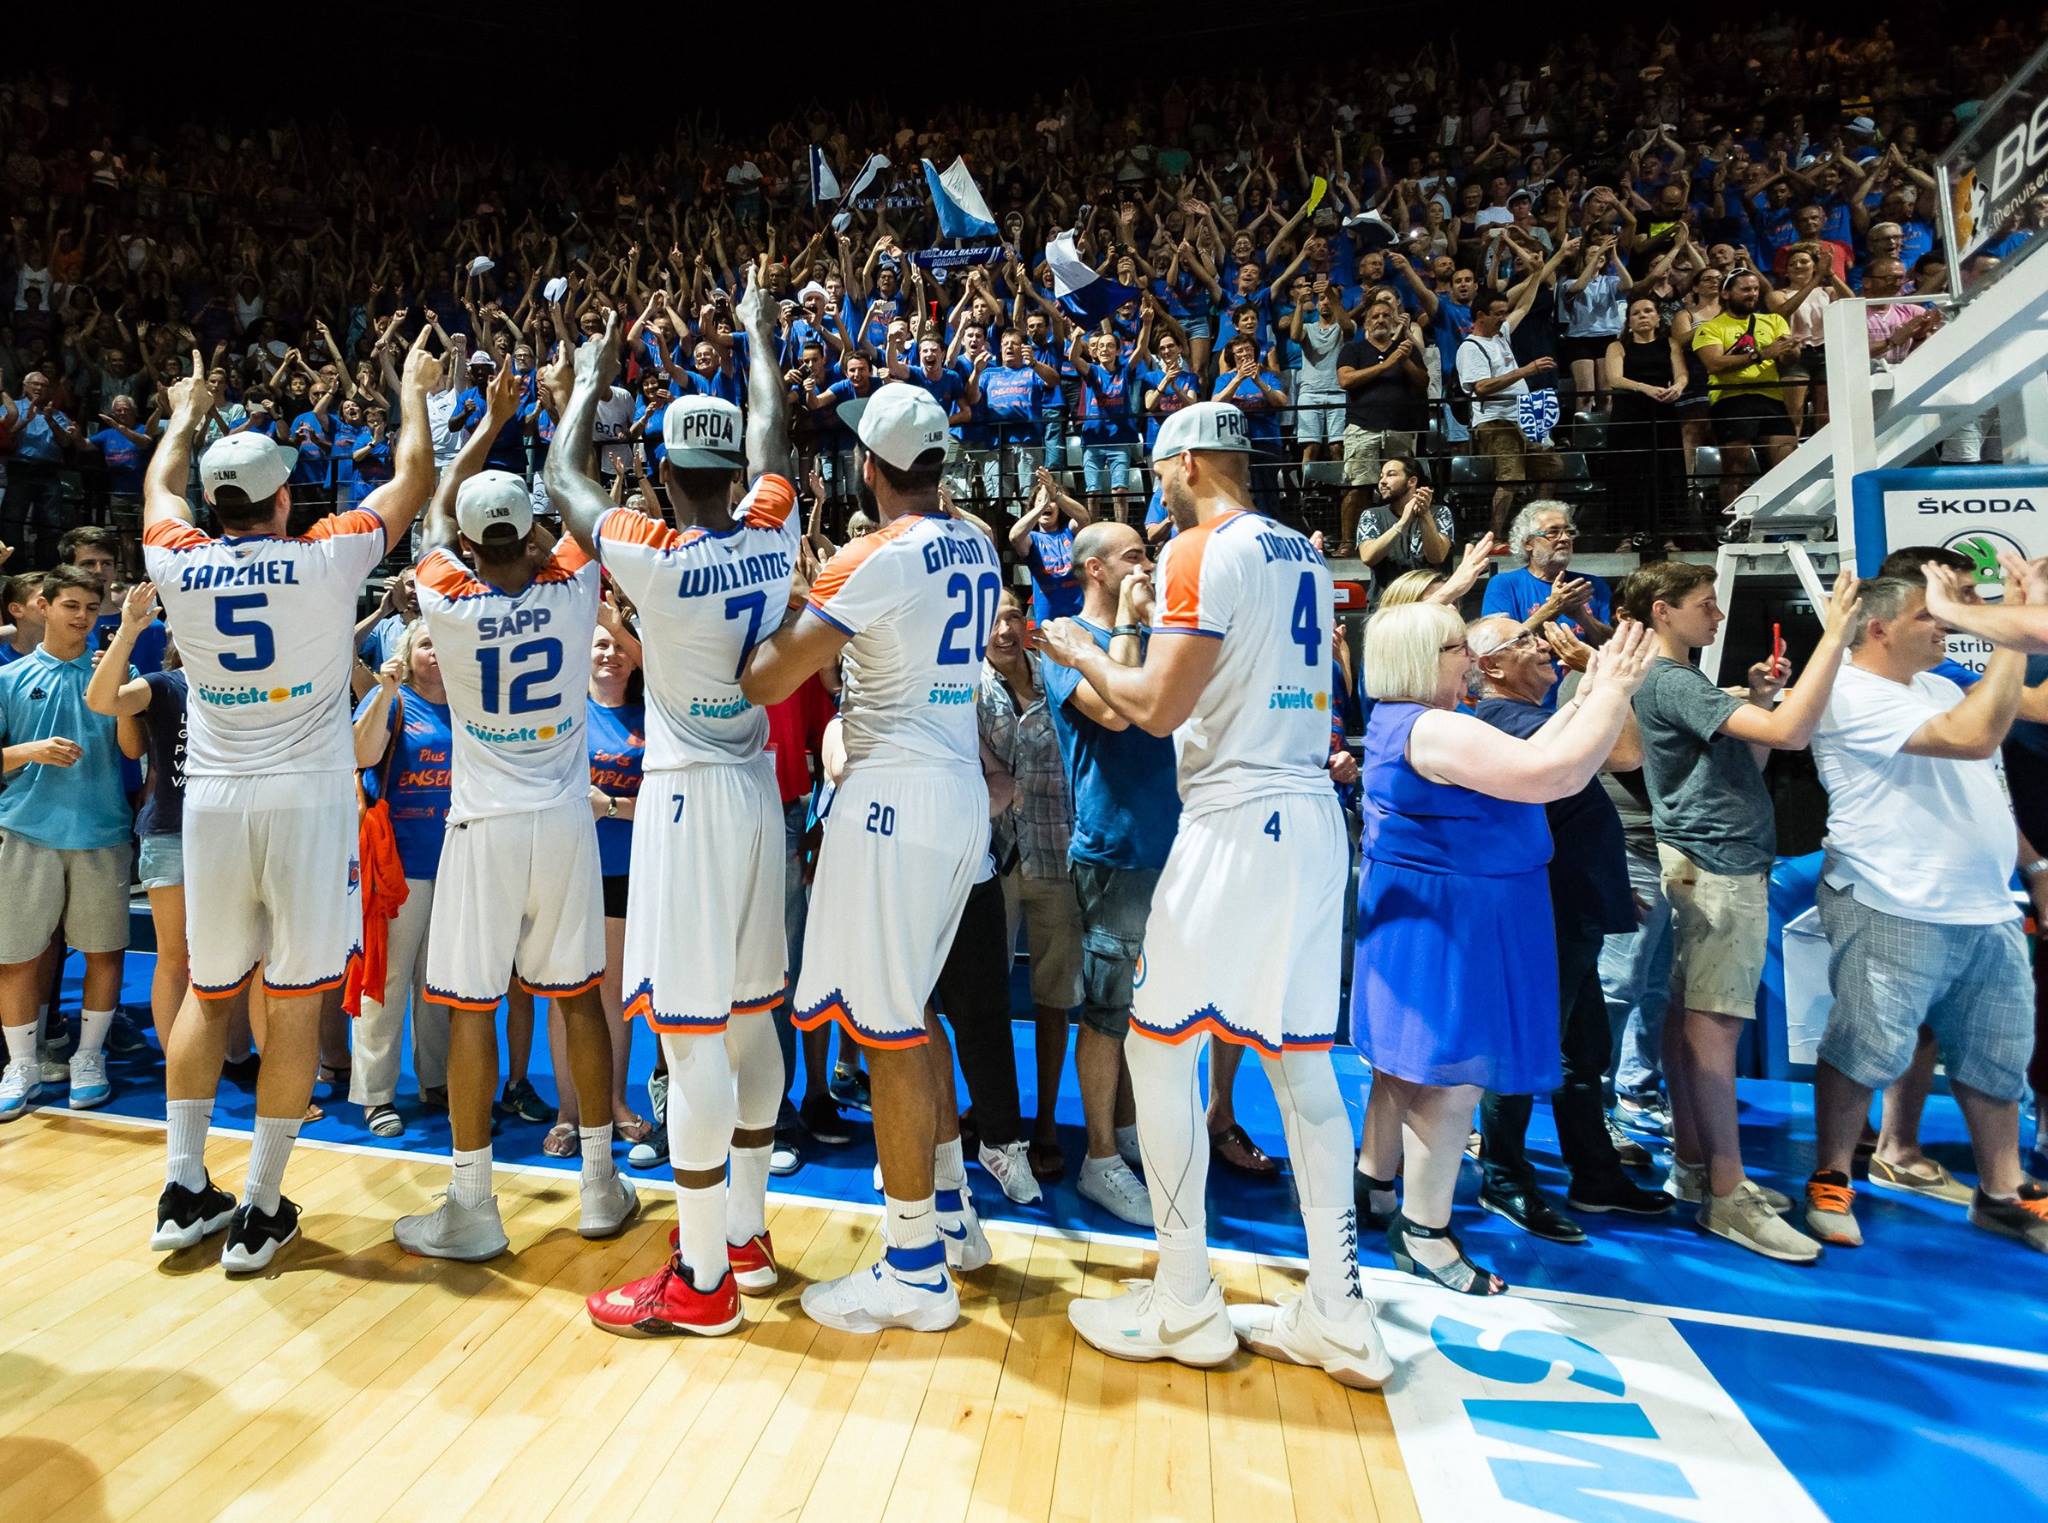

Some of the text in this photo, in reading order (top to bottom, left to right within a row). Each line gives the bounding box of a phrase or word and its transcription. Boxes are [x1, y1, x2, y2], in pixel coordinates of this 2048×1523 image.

[958, 247, 989, 257] BASKET
[217, 470, 237, 480] LNB
[491, 507, 511, 518] LNB
[1918, 497, 2036, 514] ŠKODA
[180, 560, 299, 592] SANCHEZ
[678, 552, 791, 598] WILLIAMS
[214, 592, 275, 672] 5
[477, 608, 551, 640] SAPP
[937, 572, 1000, 665] 20
[1291, 571, 1322, 666] 4
[724, 590, 767, 680] 7
[475, 637, 563, 715] 12
[419, 748, 446, 762] Plus
[672, 795, 684, 823] 7
[866, 802, 895, 836] 20
[1263, 811, 1281, 842] 4
